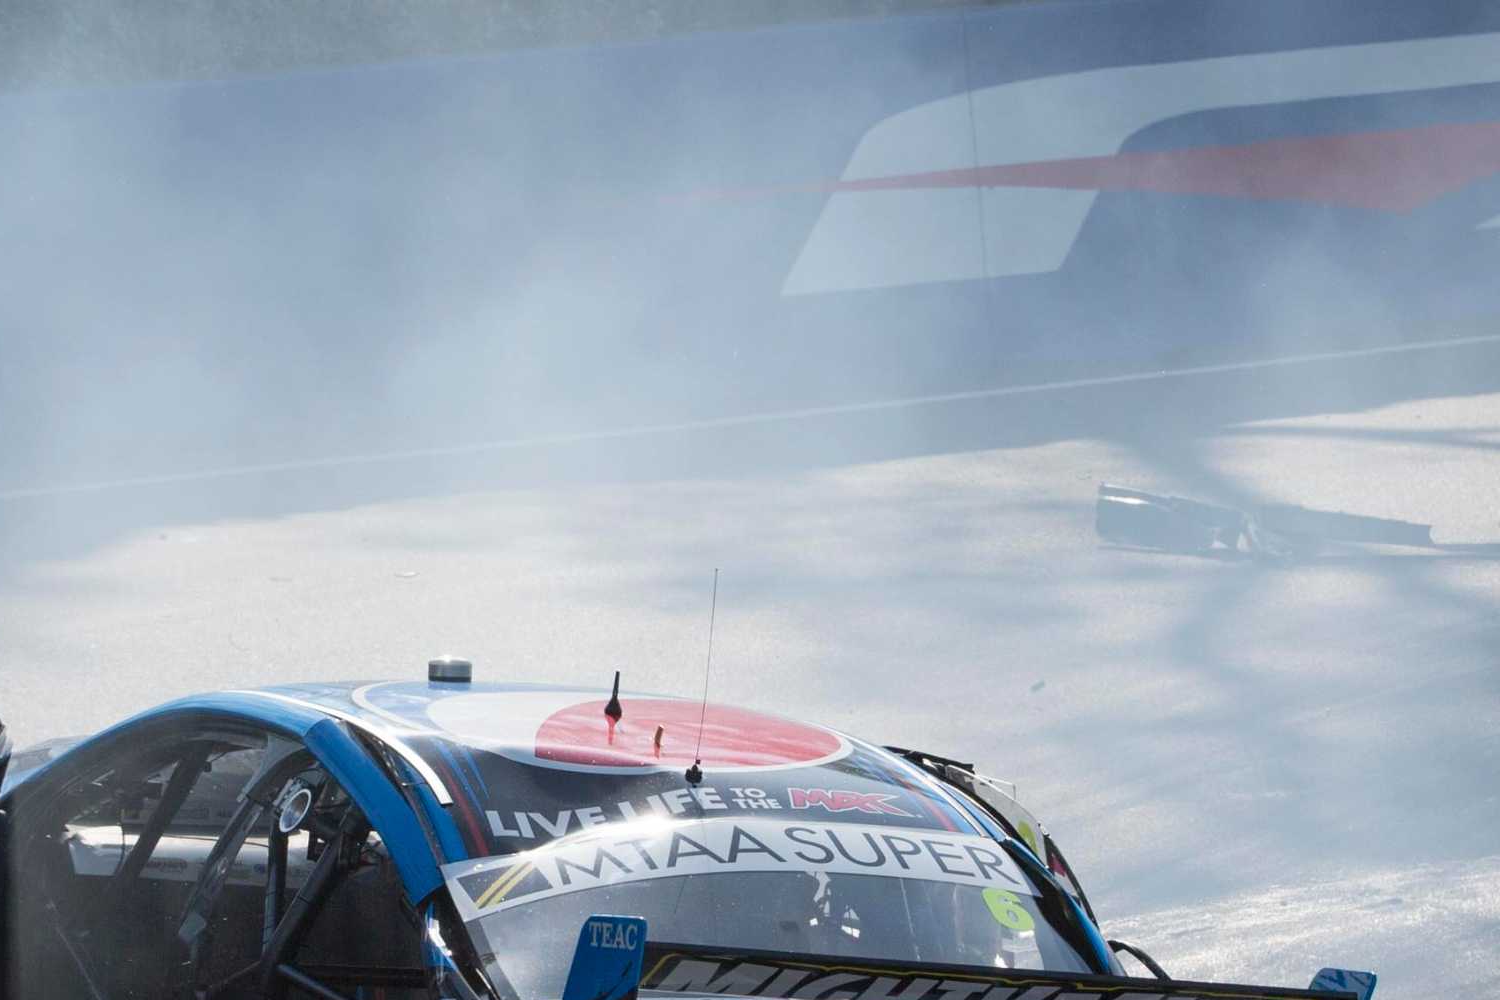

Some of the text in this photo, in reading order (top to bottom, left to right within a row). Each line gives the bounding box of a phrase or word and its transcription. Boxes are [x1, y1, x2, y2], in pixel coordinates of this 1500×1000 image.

[485, 787, 767, 838] LIVE LIFE TO
[731, 798, 782, 809] THE
[787, 787, 922, 818] MAX
[555, 825, 1022, 885] MTAA SUPER
[981, 887, 1035, 931] 6
[589, 922, 638, 950] TEAC
